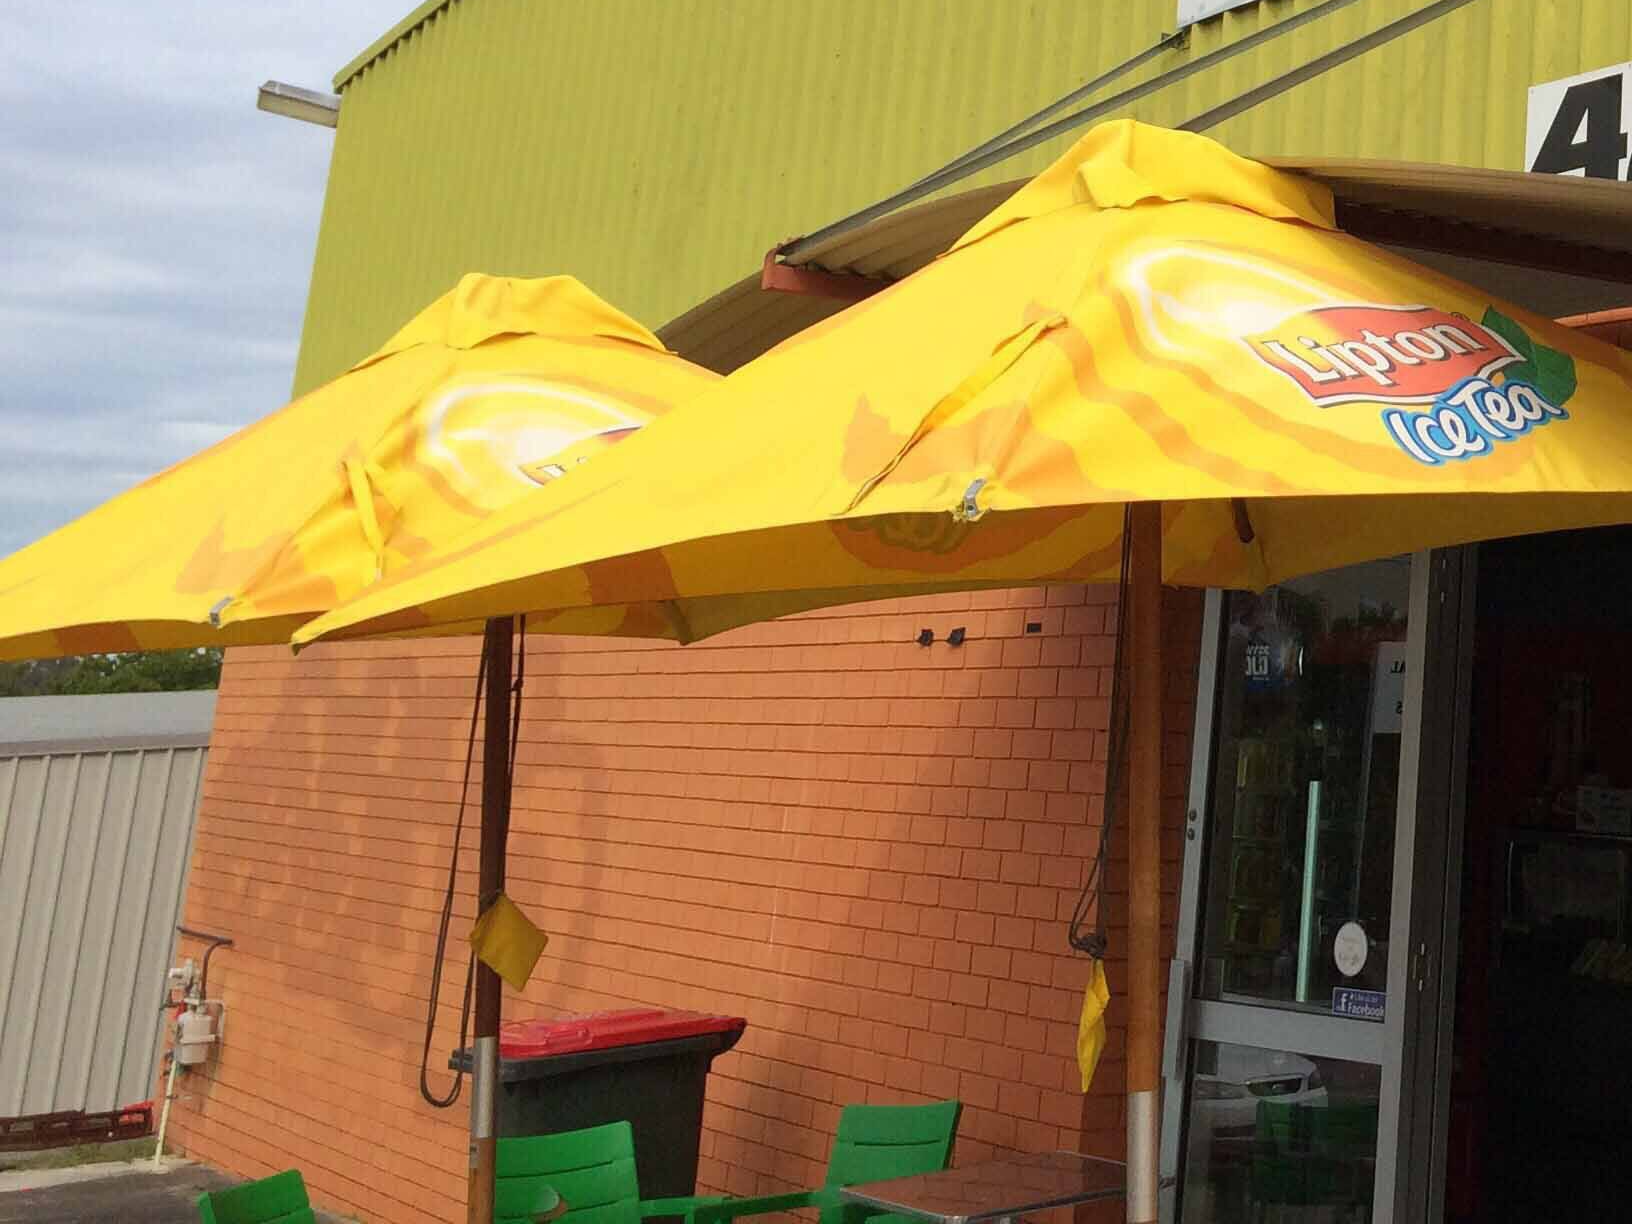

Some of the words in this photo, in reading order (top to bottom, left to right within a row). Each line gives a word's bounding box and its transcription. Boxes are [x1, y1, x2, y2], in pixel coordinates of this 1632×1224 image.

[1266, 322, 1488, 385] Lipton
[1387, 408, 1484, 464] Ice
[1446, 378, 1566, 439] Tea
